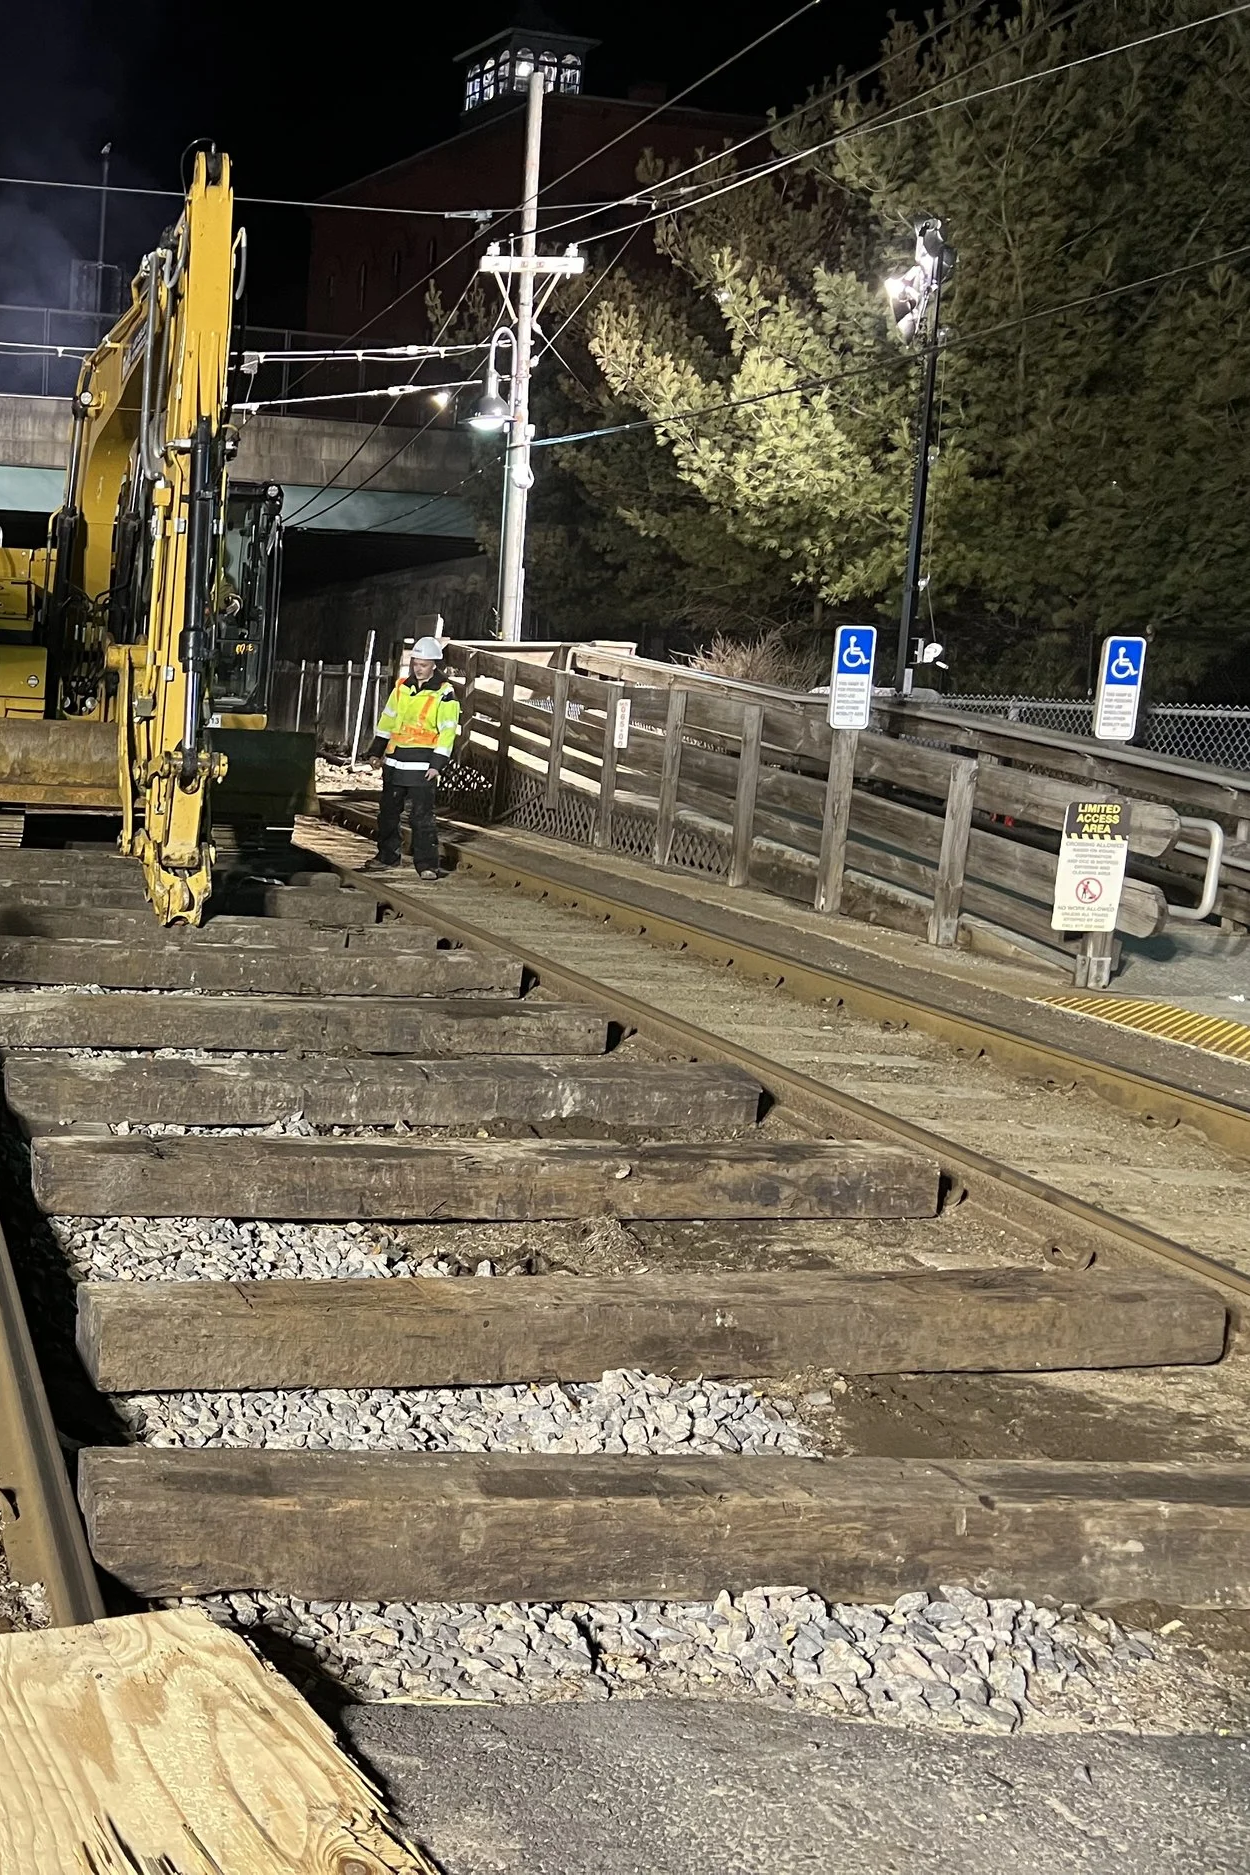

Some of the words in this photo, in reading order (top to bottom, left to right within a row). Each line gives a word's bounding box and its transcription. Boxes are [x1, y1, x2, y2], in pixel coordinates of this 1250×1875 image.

[1078, 803, 1121, 813] LIMITED
[1076, 813, 1120, 824] ACCESS
[1082, 823, 1111, 833] AREA
